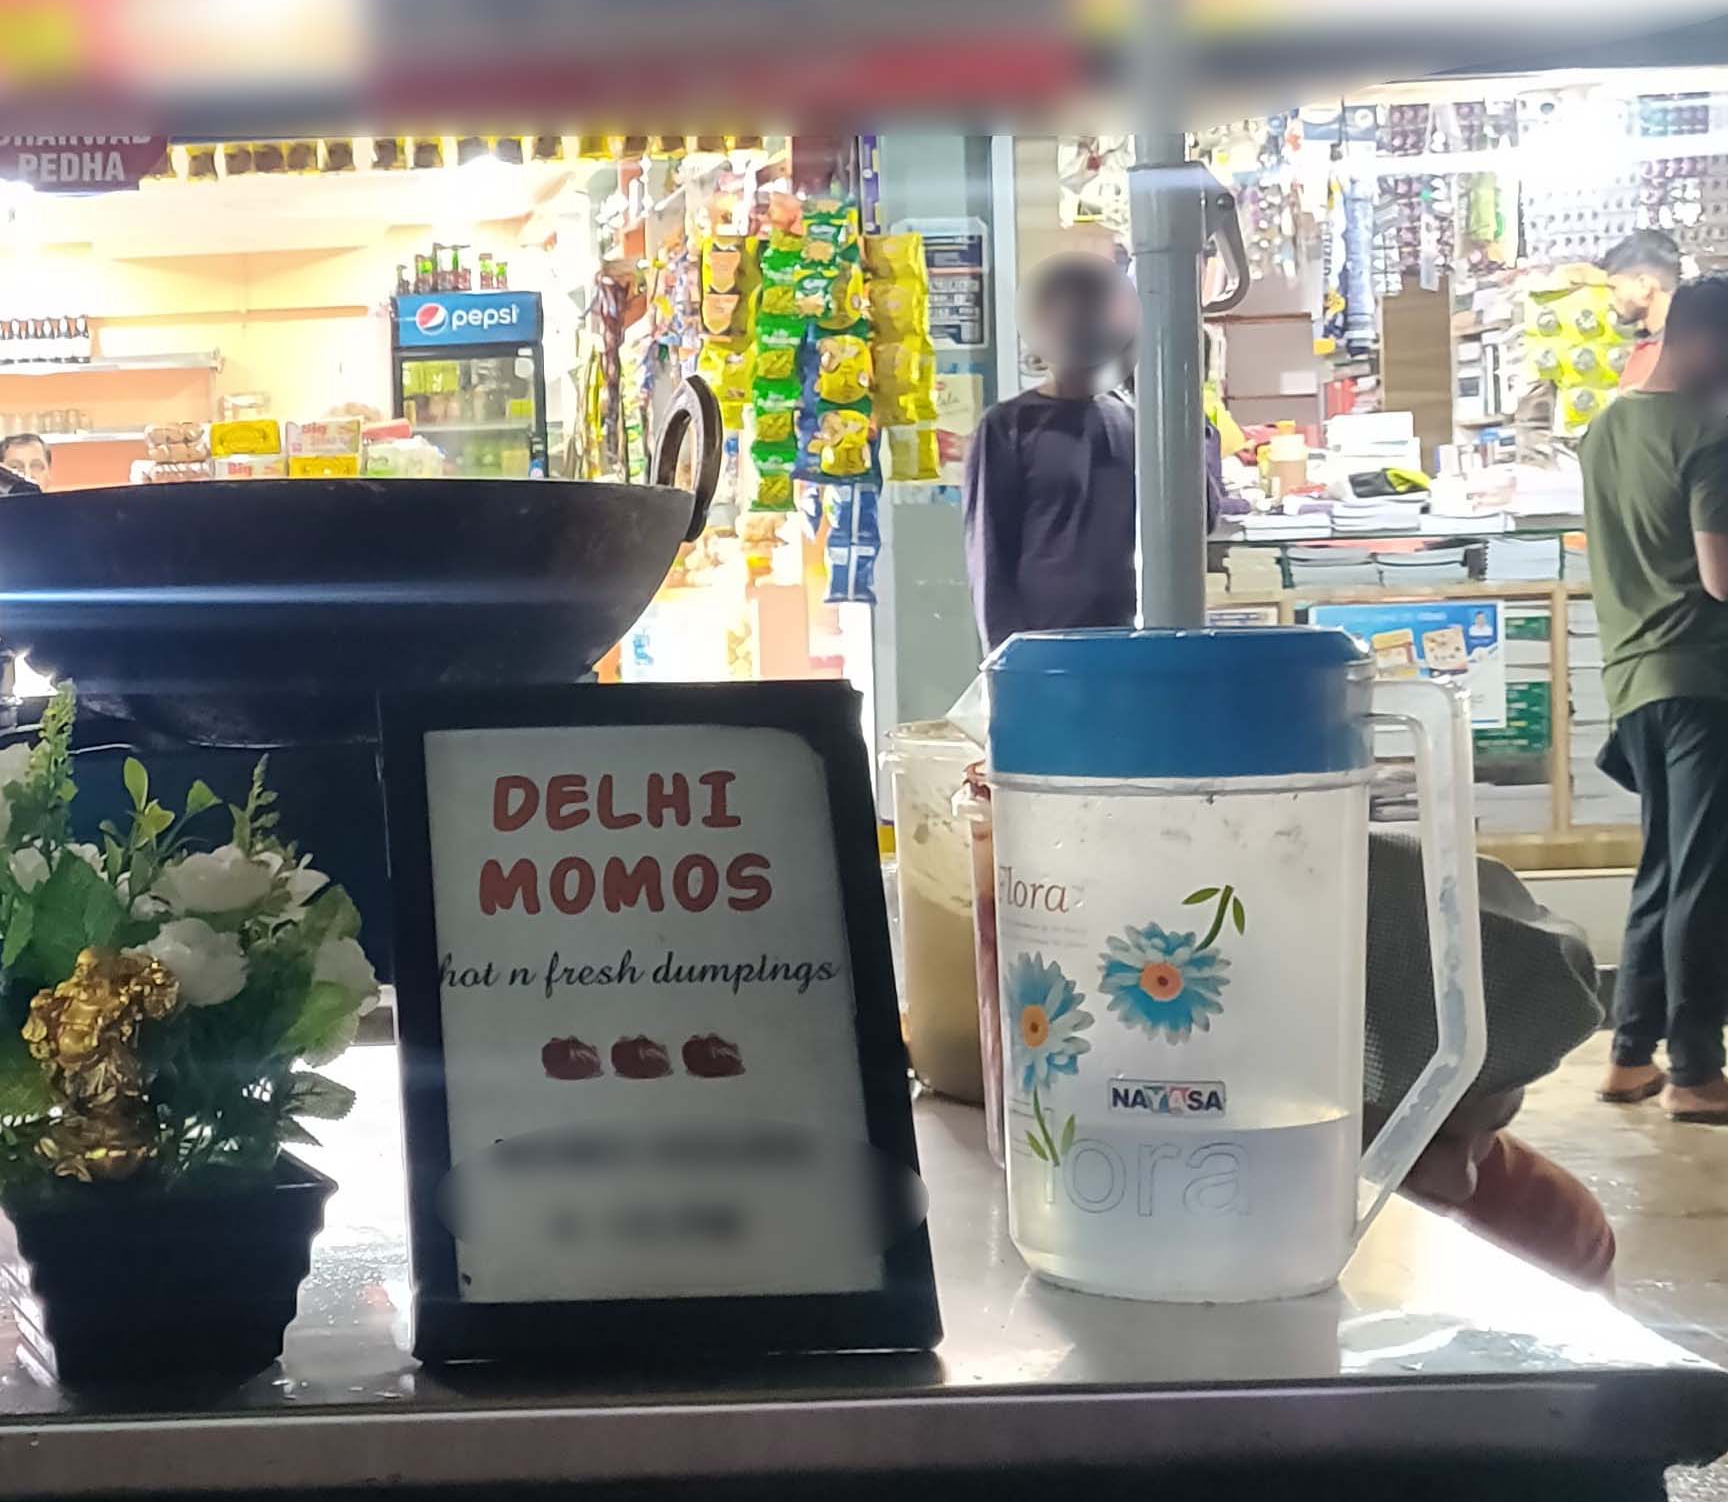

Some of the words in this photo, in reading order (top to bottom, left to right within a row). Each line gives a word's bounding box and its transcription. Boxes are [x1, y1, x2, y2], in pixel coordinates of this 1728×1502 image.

[18, 151, 125, 182] PEDHA
[452, 304, 517, 330] pepsi
[492, 770, 742, 832] DELHI
[478, 854, 772, 915] MOMOS
[440, 952, 501, 987] hot
[508, 967, 536, 986] n
[544, 949, 645, 998] fresh
[1111, 1085, 1223, 1113] NAYASA
